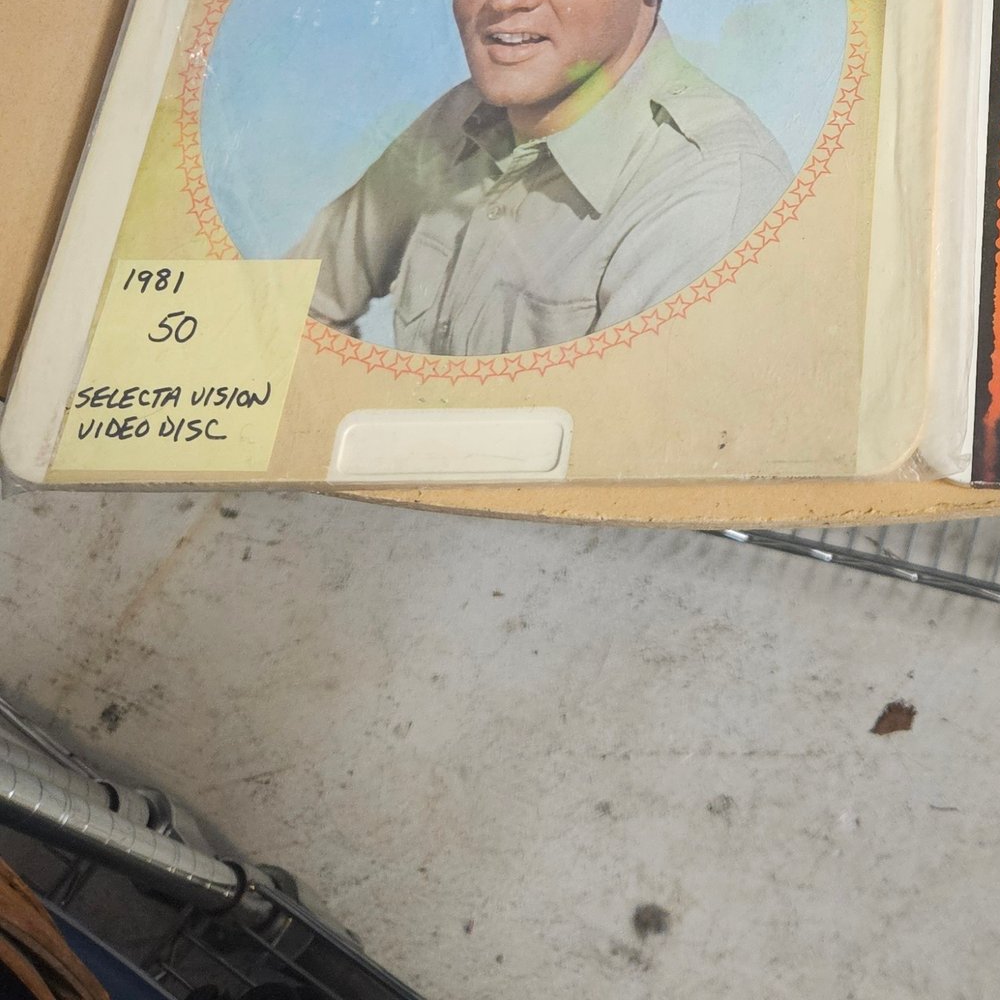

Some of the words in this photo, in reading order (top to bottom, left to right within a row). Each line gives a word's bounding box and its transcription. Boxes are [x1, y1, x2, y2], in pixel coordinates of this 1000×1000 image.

[123, 268, 185, 294] 1981
[148, 310, 198, 343] 50
[75, 386, 182, 409] SELECTA
[190, 381, 271, 409] VISION
[78, 415, 150, 440] VIDEO
[158, 415, 228, 442] DISC
